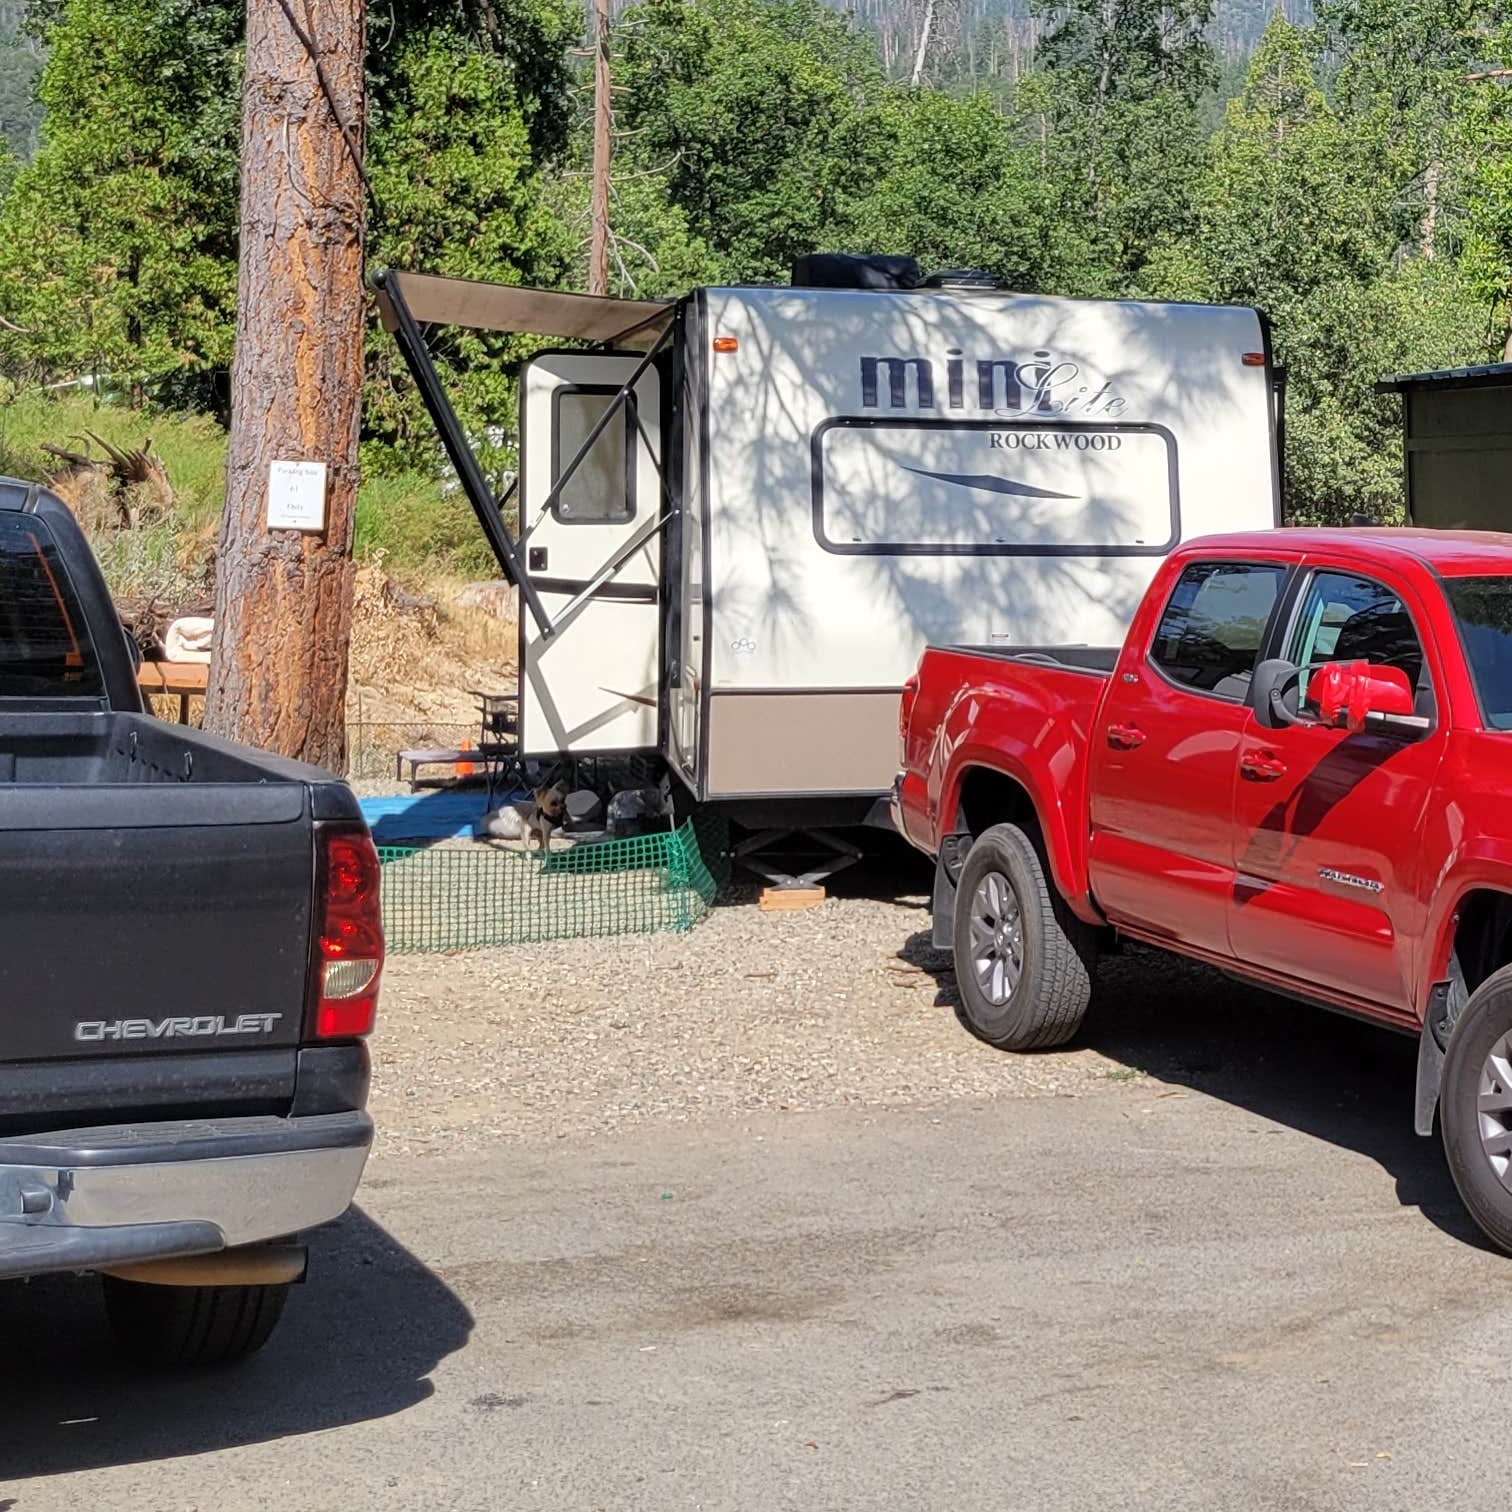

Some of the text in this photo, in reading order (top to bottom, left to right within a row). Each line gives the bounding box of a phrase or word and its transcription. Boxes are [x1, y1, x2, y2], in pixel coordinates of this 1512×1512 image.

[860, 348, 1130, 418] mini Lite
[989, 432, 1122, 451] ROCKWOOD
[75, 1012, 283, 1041] CHEVROLET
